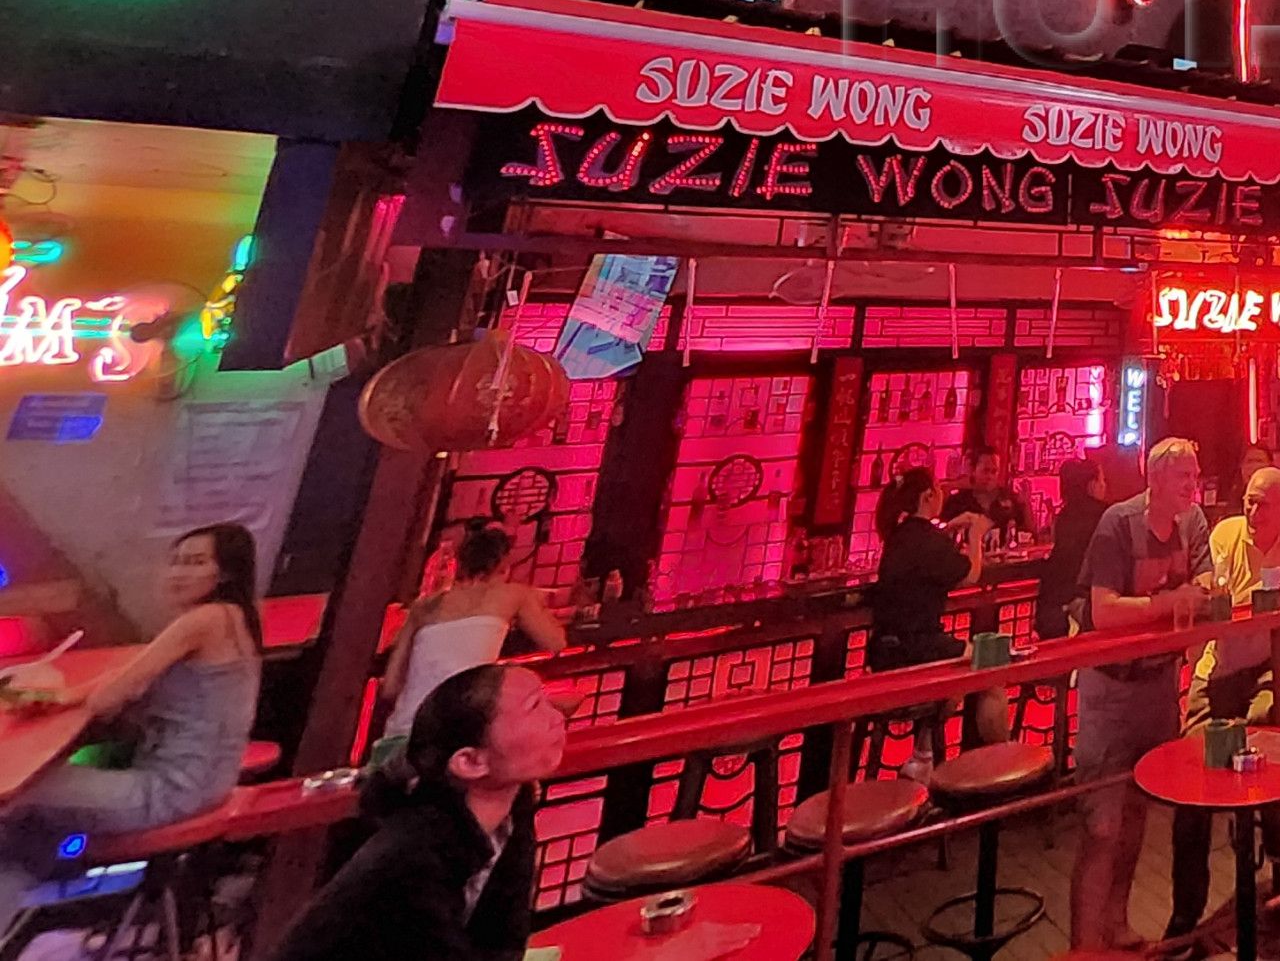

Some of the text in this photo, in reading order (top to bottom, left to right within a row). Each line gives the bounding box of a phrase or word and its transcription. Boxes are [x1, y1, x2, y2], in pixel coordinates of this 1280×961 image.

[636, 56, 932, 132] SUZIE WONG
[1022, 104, 1224, 164] SUZIE WONG
[500, 123, 1056, 214] SUZIE WONG
[1089, 173, 1264, 226] SUZIE
[1154, 287, 1264, 333] SUZIE
